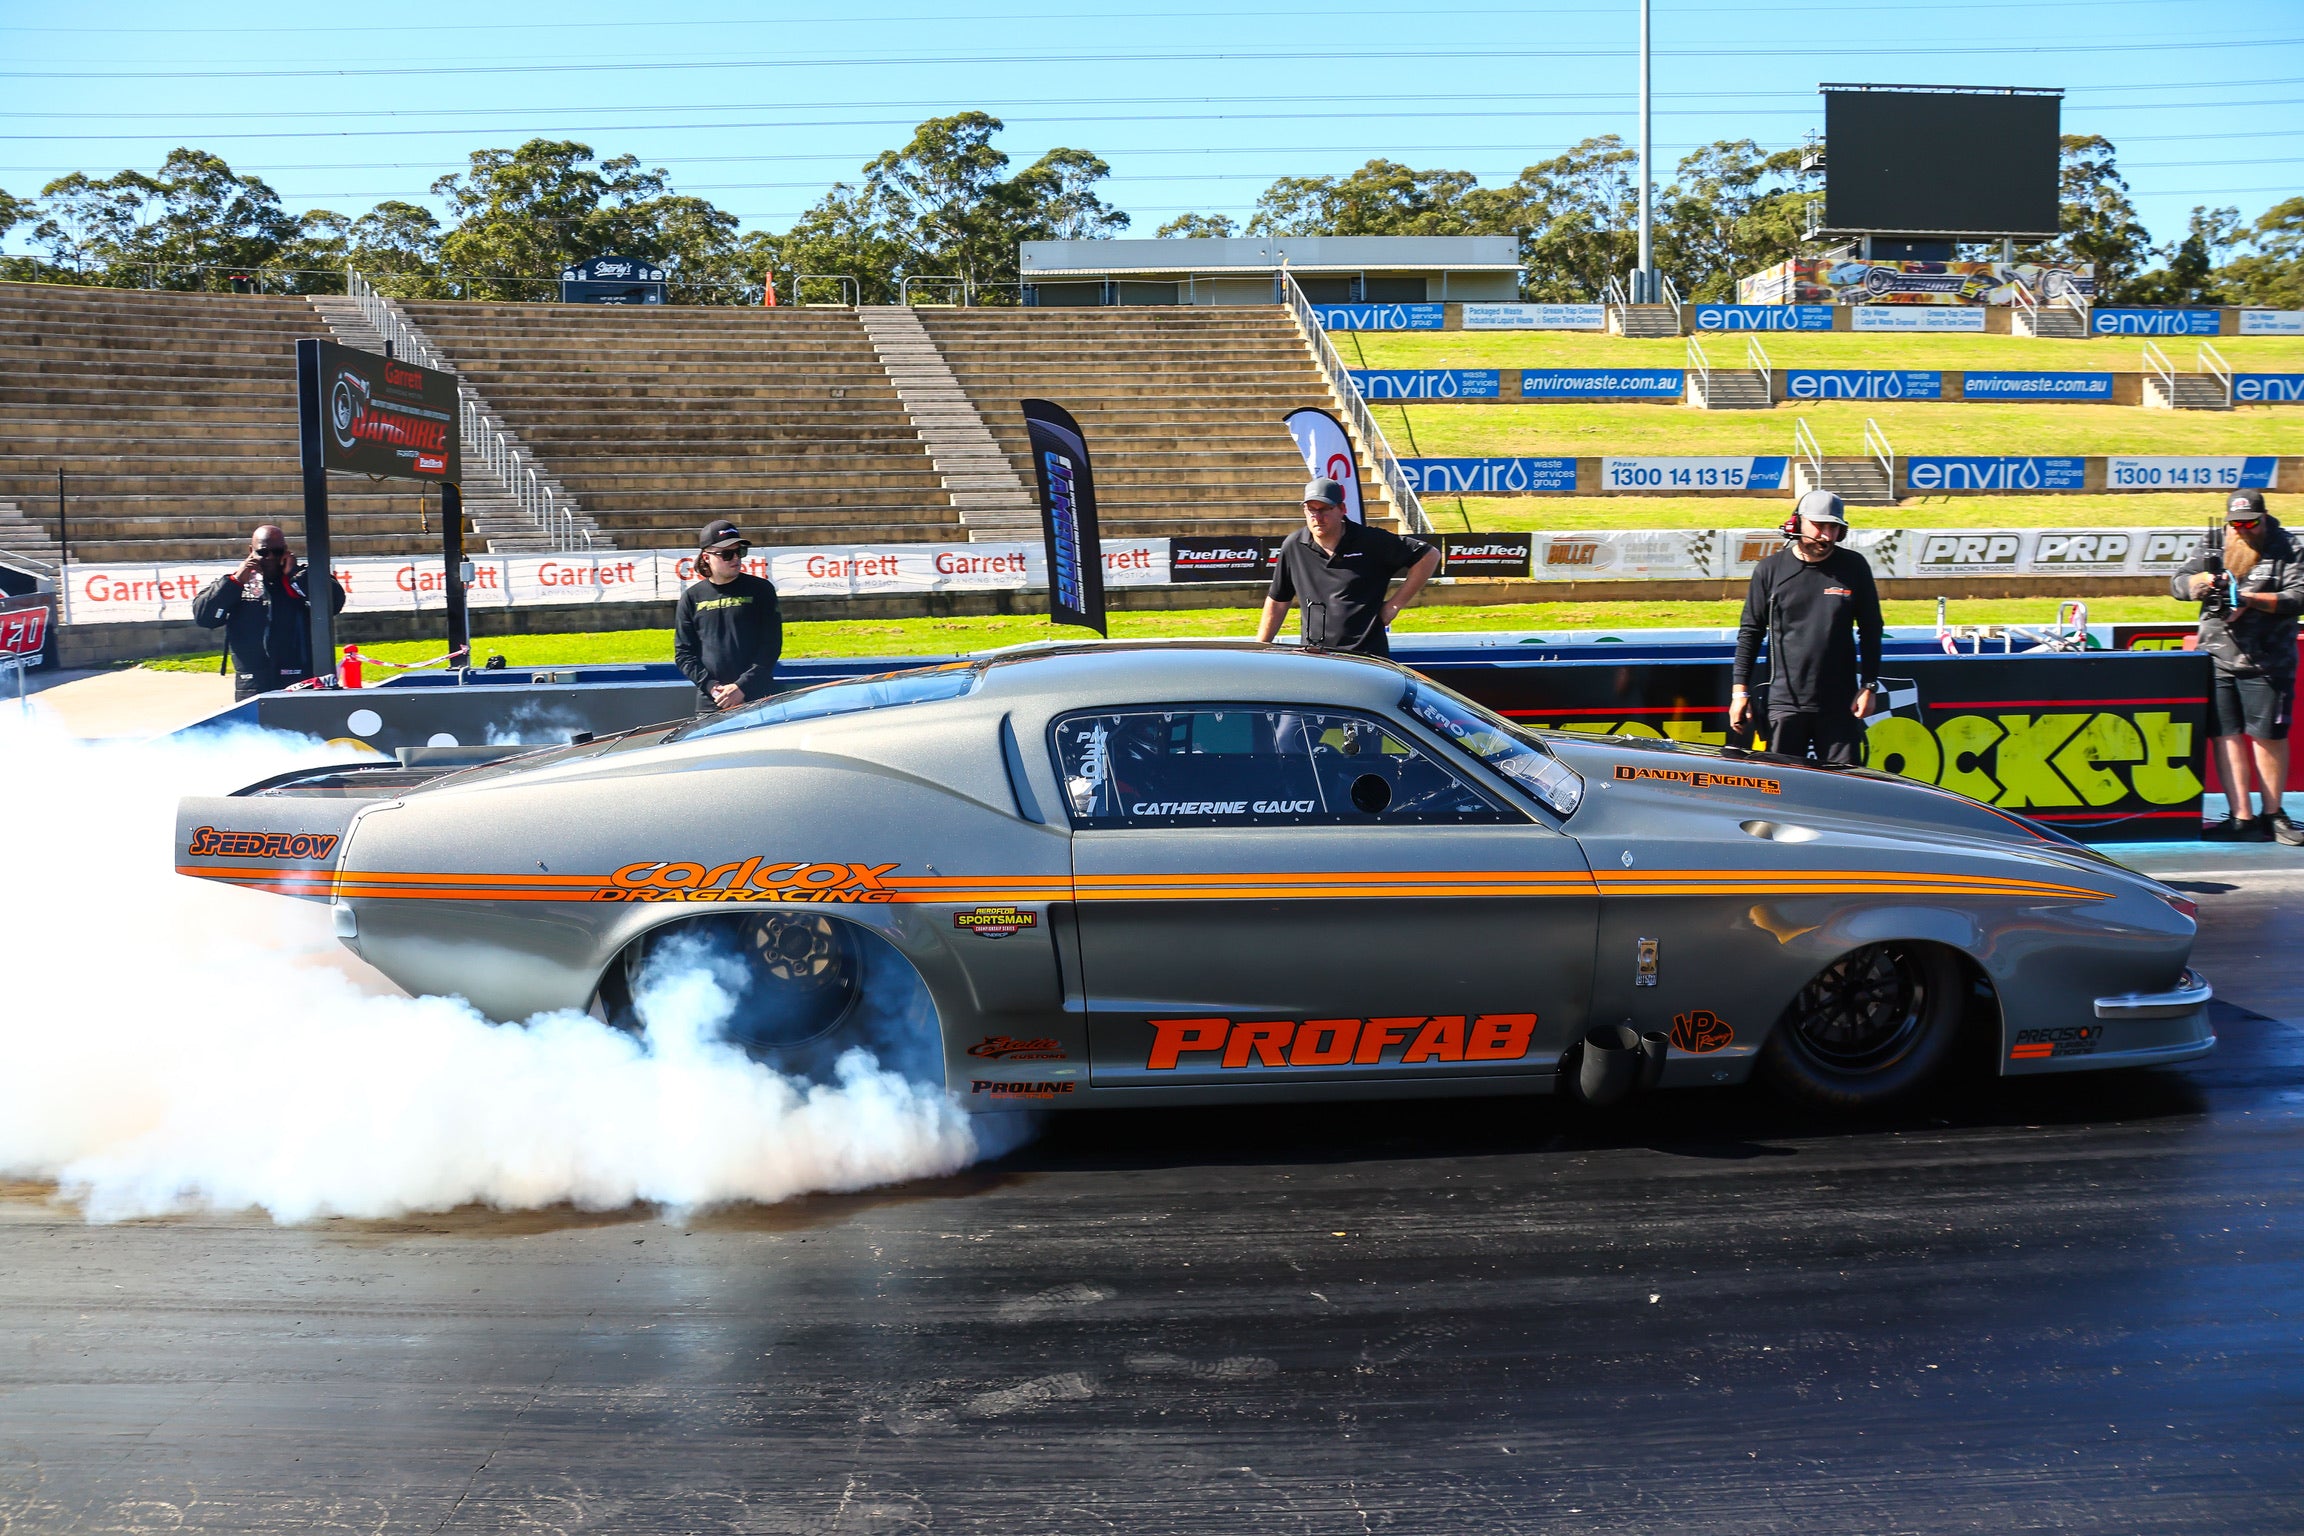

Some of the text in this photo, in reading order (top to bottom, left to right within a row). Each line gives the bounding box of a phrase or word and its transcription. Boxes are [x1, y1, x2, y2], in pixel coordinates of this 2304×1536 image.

[594, 261, 632, 278] Shorty's
[385, 362, 423, 390] Garrett
[1524, 374, 1677, 391] envirowaste.com.au
[1965, 376, 2107, 392] envirowaste.com.au
[1461, 387, 1486, 395] group
[2237, 379, 2304, 400] env
[351, 398, 448, 450] JAMBOREE
[1533, 469, 1575, 478] services
[1534, 460, 1562, 468] waste
[1533, 478, 1561, 487] group
[1611, 469, 1743, 485] 1300 14 13 15
[2114, 468, 2238, 484] 1300 14 13 15
[1044, 451, 1080, 613] JAMBOREE
[1101, 548, 1151, 569] rrett
[1177, 548, 1258, 560] FuelTech
[1449, 545, 1528, 557] FuelTech
[1547, 543, 1598, 565] BULLET
[1922, 537, 2019, 563] PRP
[2035, 535, 2129, 562] PRP
[2145, 536, 2198, 561] PR
[538, 562, 635, 586] Garrett
[675, 557, 768, 581] Gett
[807, 555, 898, 578] Garrett
[936, 552, 1026, 575] Garrett
[85, 574, 200, 601] Garrett
[396, 566, 497, 592] Gartt
[1076, 731, 1109, 743] PM
[1860, 711, 2204, 808] ocket
[1133, 800, 1315, 815] CATHERINE GAUCI
[189, 825, 339, 860] SPEEDFLOW
[958, 915, 1032, 925] SPORTSMAN
[975, 907, 1016, 915] AEROFLOW
[1144, 1013, 1538, 1071] PROFAB
[971, 1080, 1075, 1094] PROLINE
